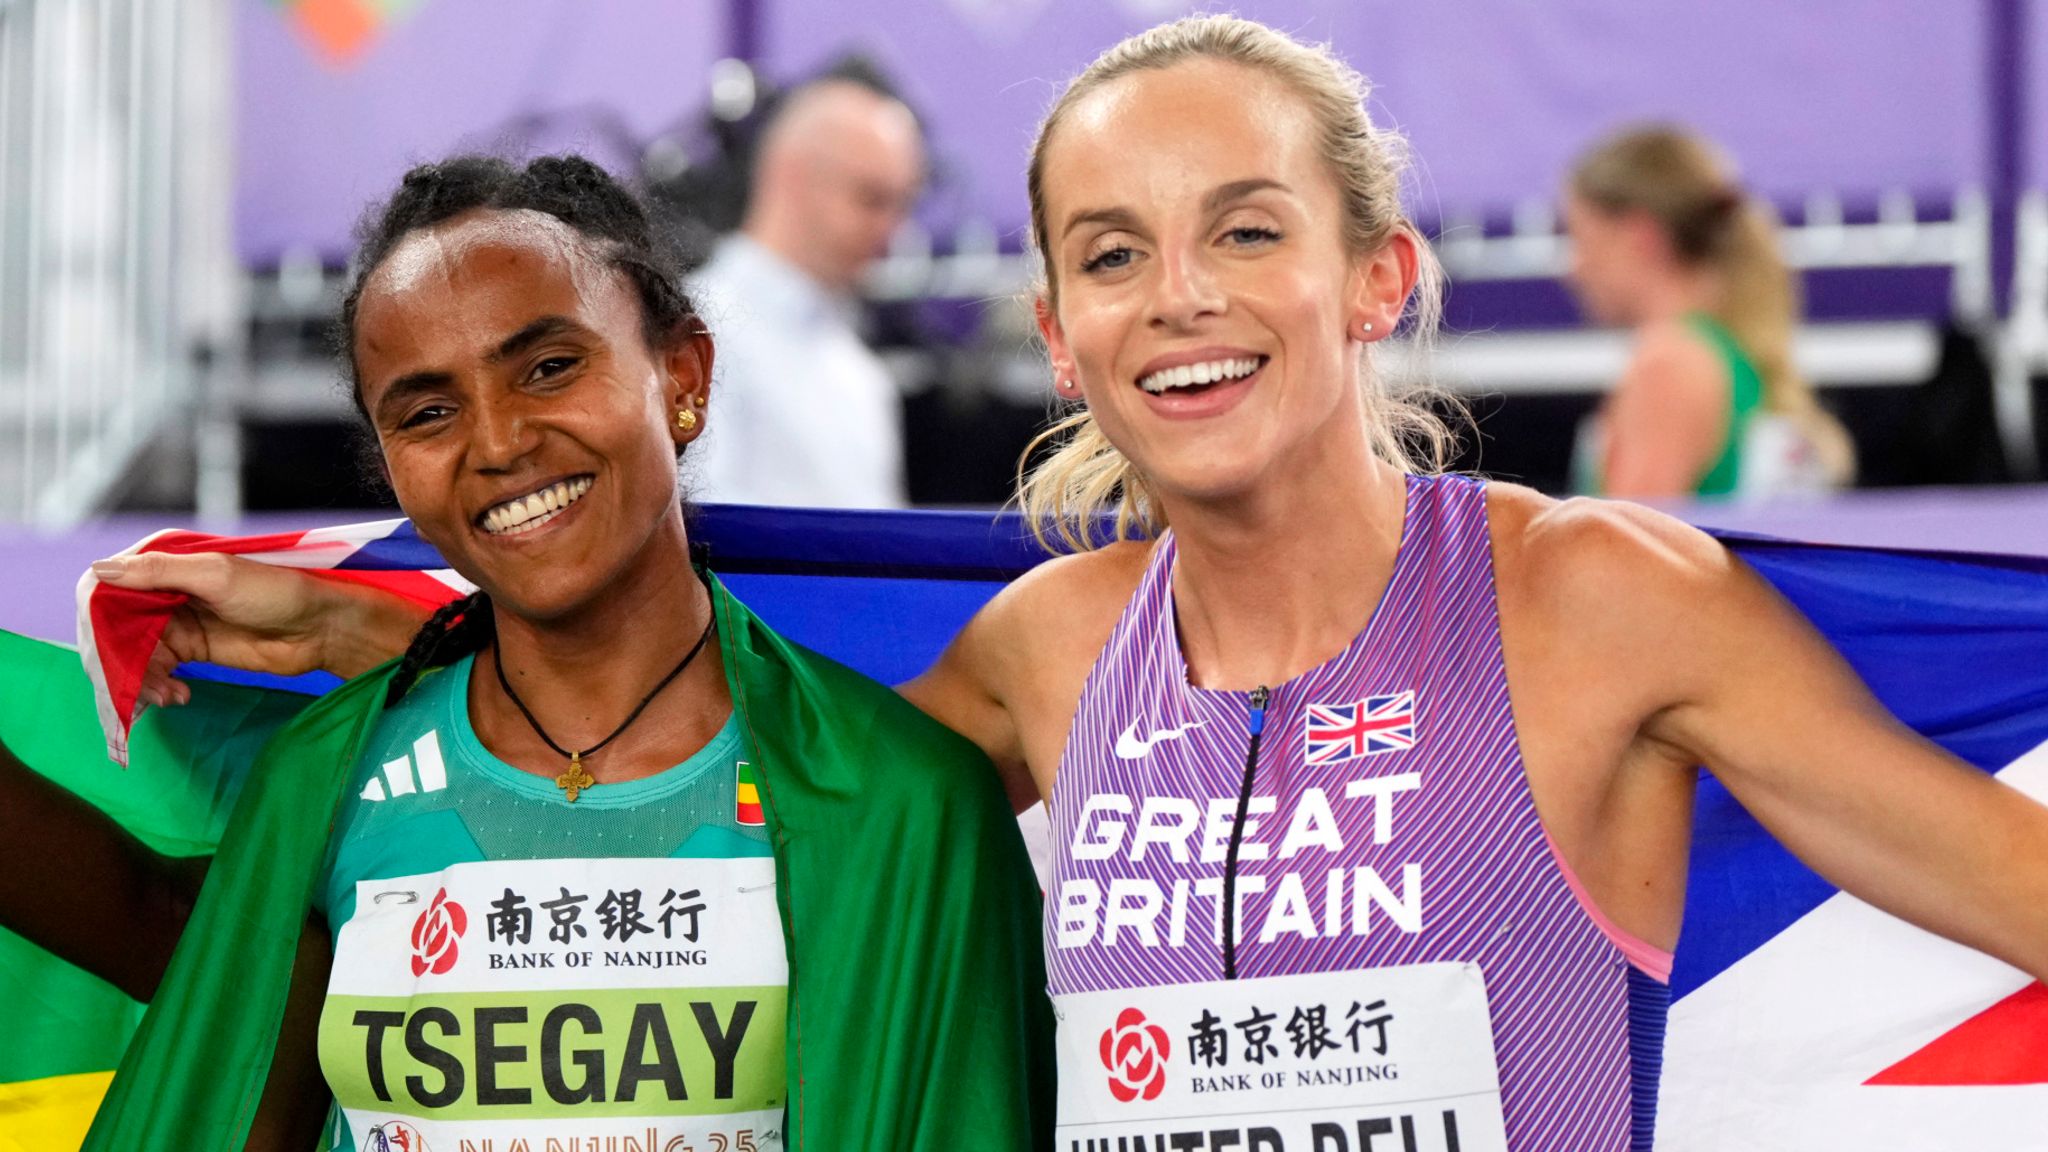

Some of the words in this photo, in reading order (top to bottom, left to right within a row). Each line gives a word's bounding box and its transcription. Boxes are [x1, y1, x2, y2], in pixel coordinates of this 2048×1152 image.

[1071, 772, 1421, 864] GREAT
[486, 886, 707, 947] 南京银行
[1057, 863, 1423, 949] BRITAIN
[488, 952, 555, 970] BANK
[565, 951, 593, 967] OF
[604, 949, 708, 969] NANJING
[352, 1000, 758, 1108] TSEGAY
[1186, 999, 1395, 1069] 南京银行
[1191, 1072, 1251, 1094] BANK
[1261, 1071, 1287, 1089] OF
[1297, 1063, 1399, 1087] NANJING
